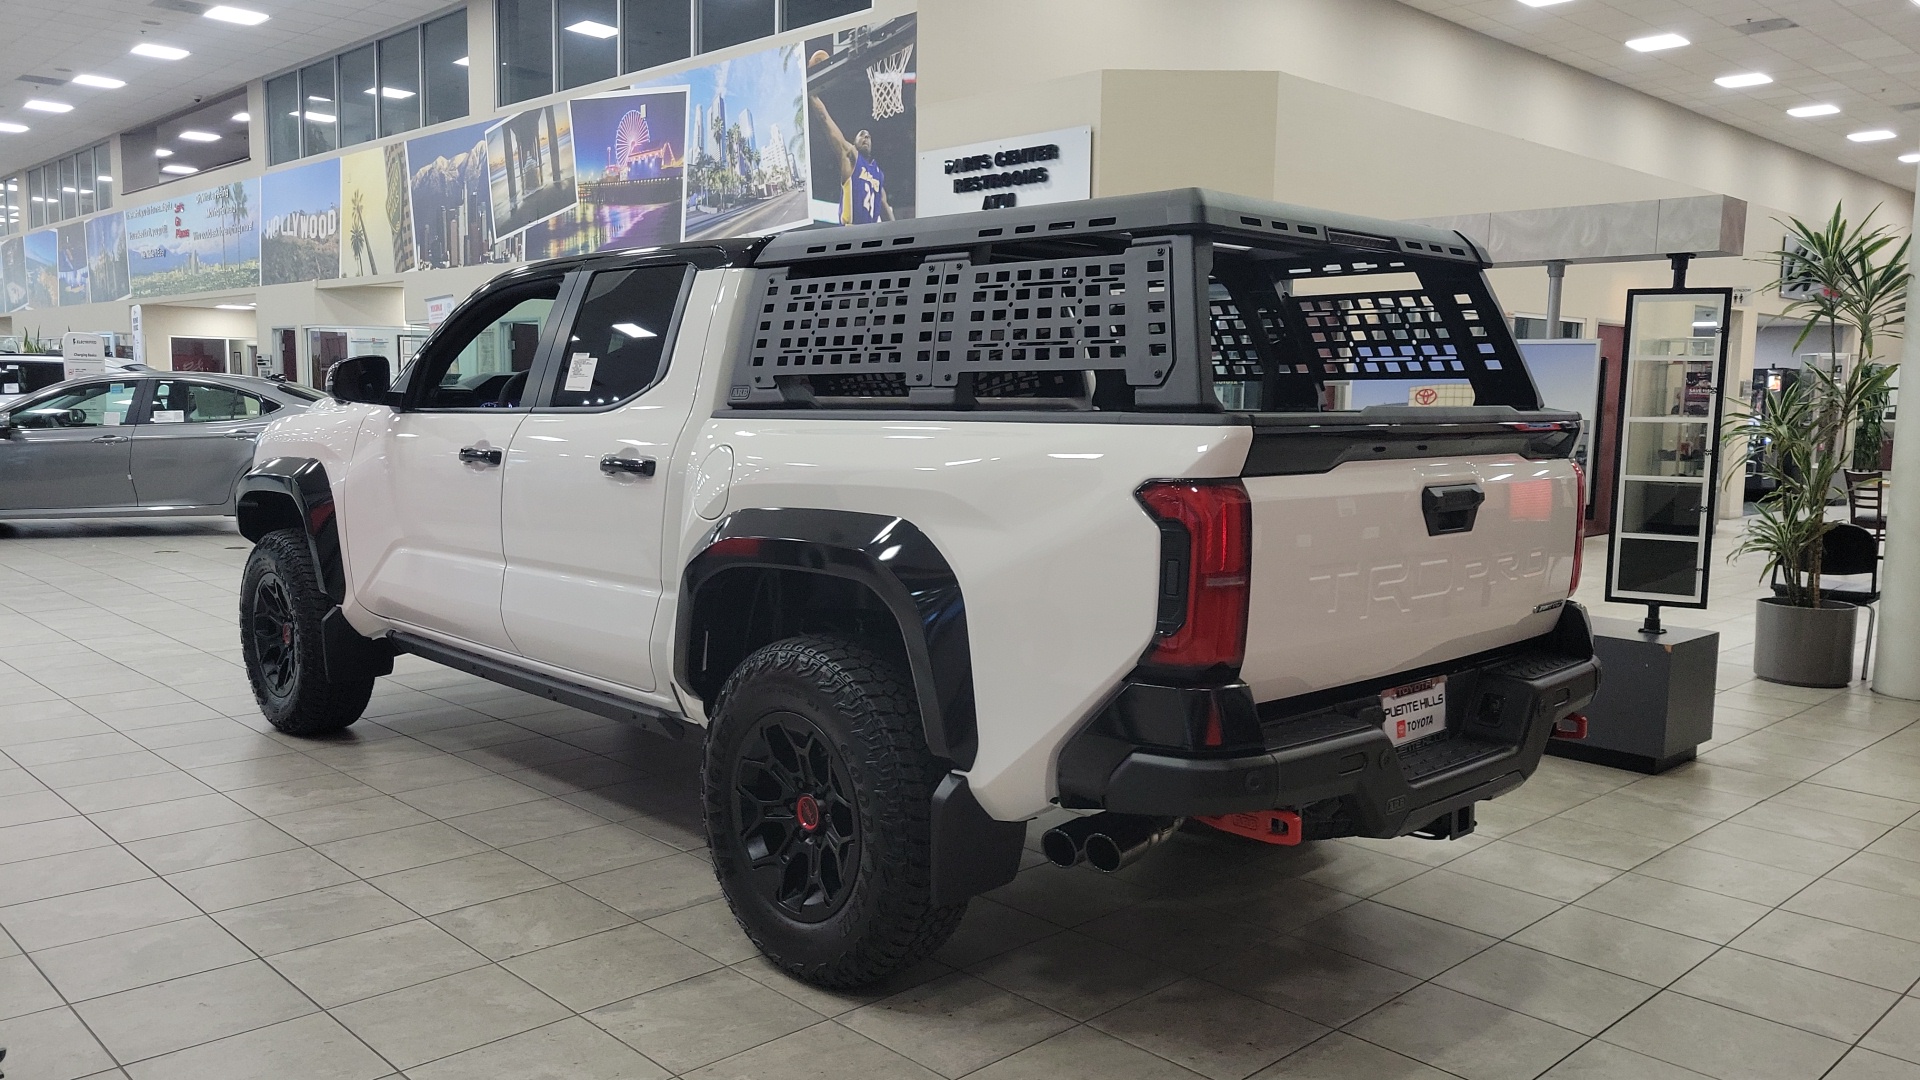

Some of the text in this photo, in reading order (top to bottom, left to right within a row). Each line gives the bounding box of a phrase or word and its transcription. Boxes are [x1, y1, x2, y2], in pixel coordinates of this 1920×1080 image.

[944, 144, 1061, 174] PARTS CENTER
[953, 166, 1049, 193] RESTROOMS
[981, 192, 1017, 210] ATM
[265, 209, 337, 240] HOLLYWOOD
[1308, 546, 1551, 620] TRD PRO
[1397, 680, 1433, 696] TOYOTA
[1384, 694, 1444, 717] PUENTE HILLS
[1407, 715, 1433, 731] TOYOTA
